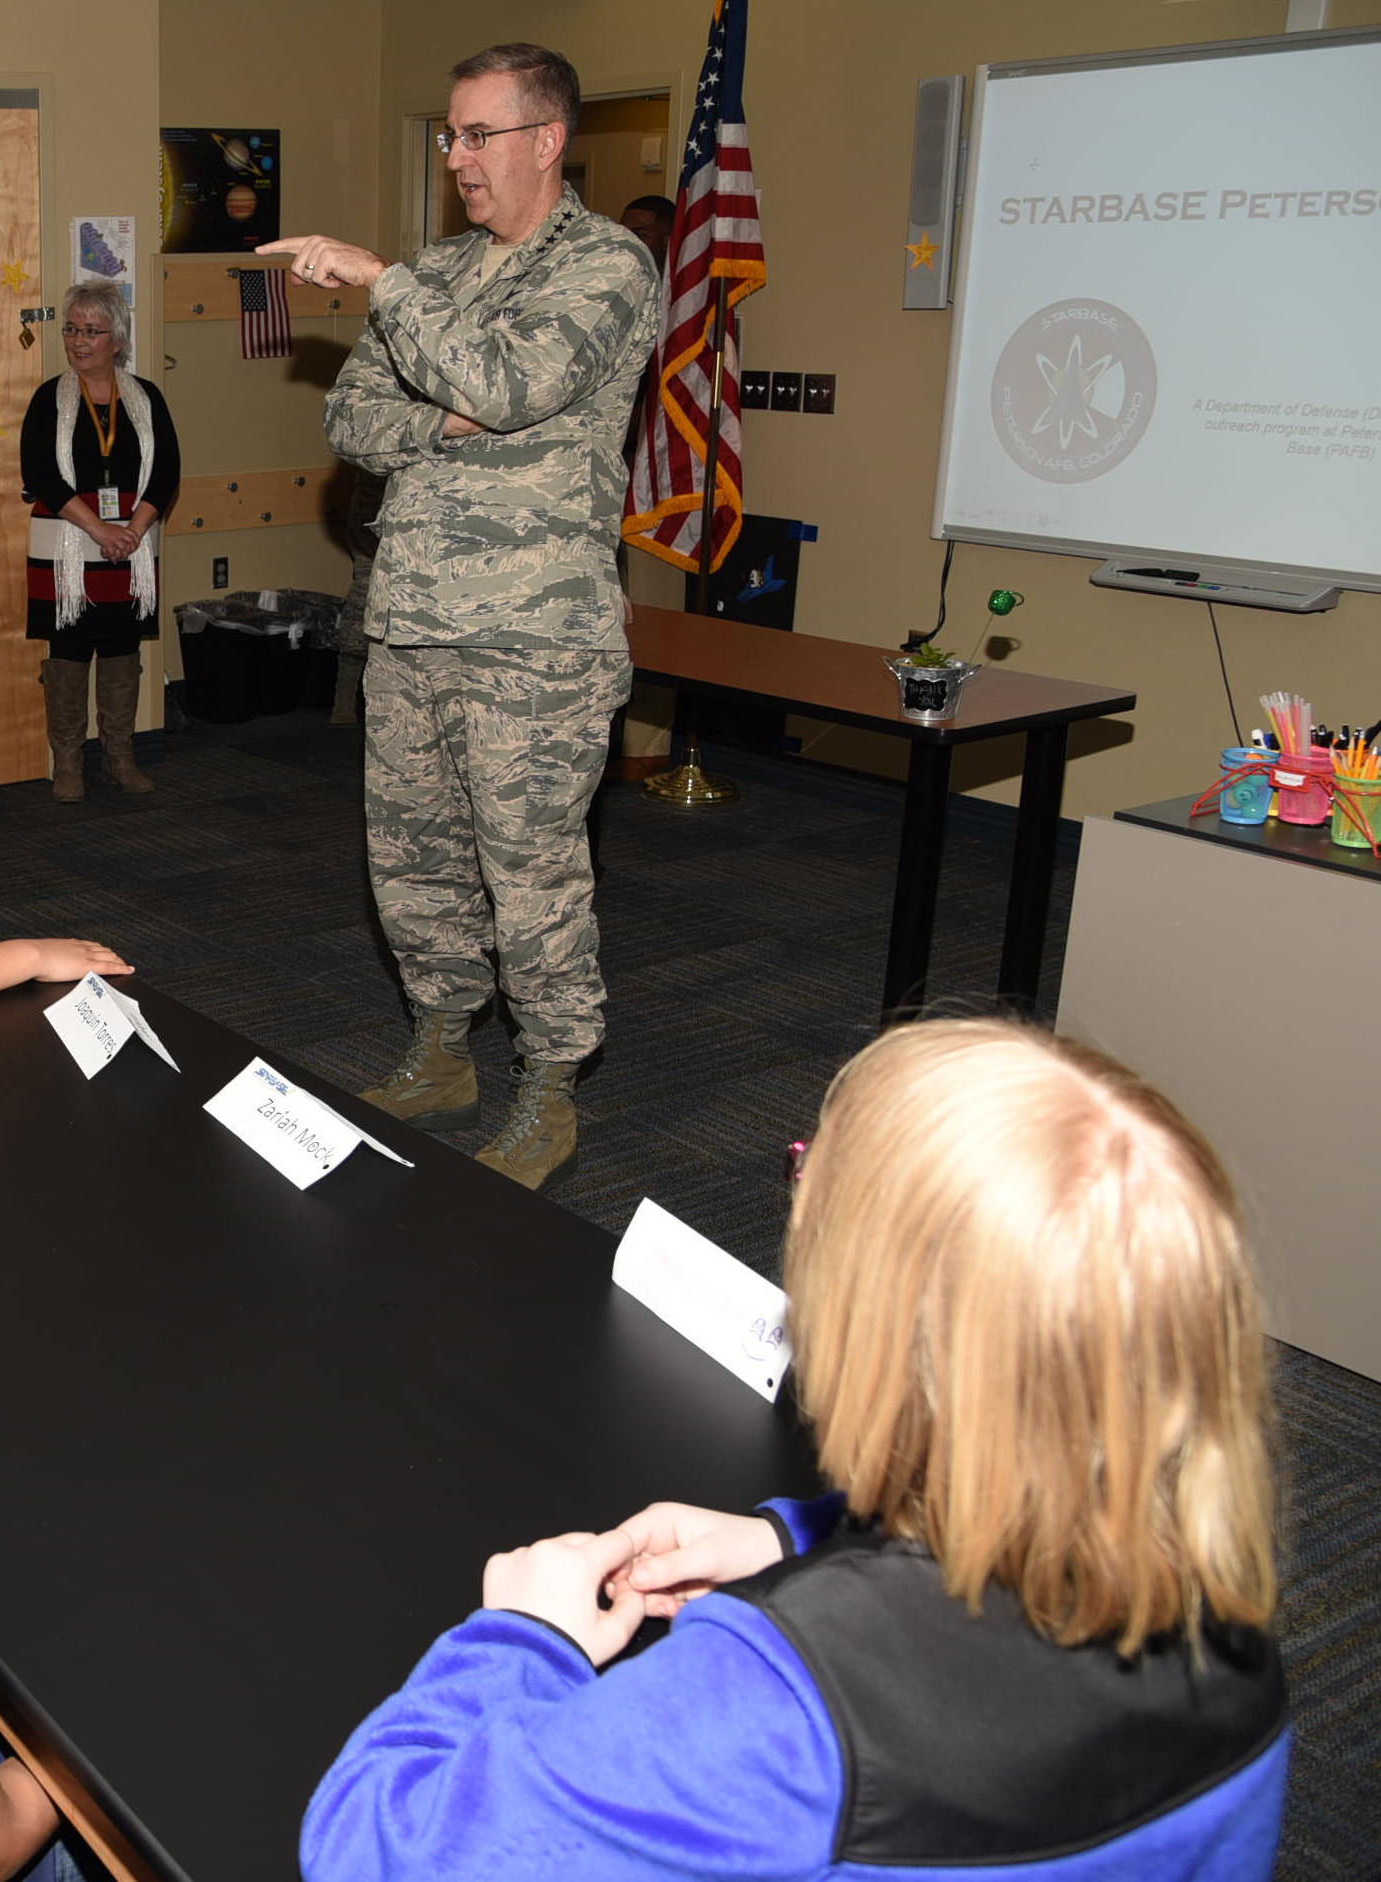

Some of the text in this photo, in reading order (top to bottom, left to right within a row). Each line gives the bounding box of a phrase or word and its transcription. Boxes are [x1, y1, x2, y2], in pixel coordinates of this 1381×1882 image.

[998, 189, 1381, 225] STARBASE PETERS
[1041, 308, 1118, 330] STARBASE
[1191, 399, 1202, 411] A
[1205, 399, 1281, 415] Department
[1285, 403, 1298, 416] of
[1301, 403, 1359, 419] Defense
[1204, 418, 1260, 433] outreach
[1262, 422, 1320, 438] program
[1323, 426, 1337, 437] at
[1286, 441, 1376, 462] Base (PAFB)
[95, 1021, 117, 1054] Torres
[257, 1098, 299, 1137] Zariah
